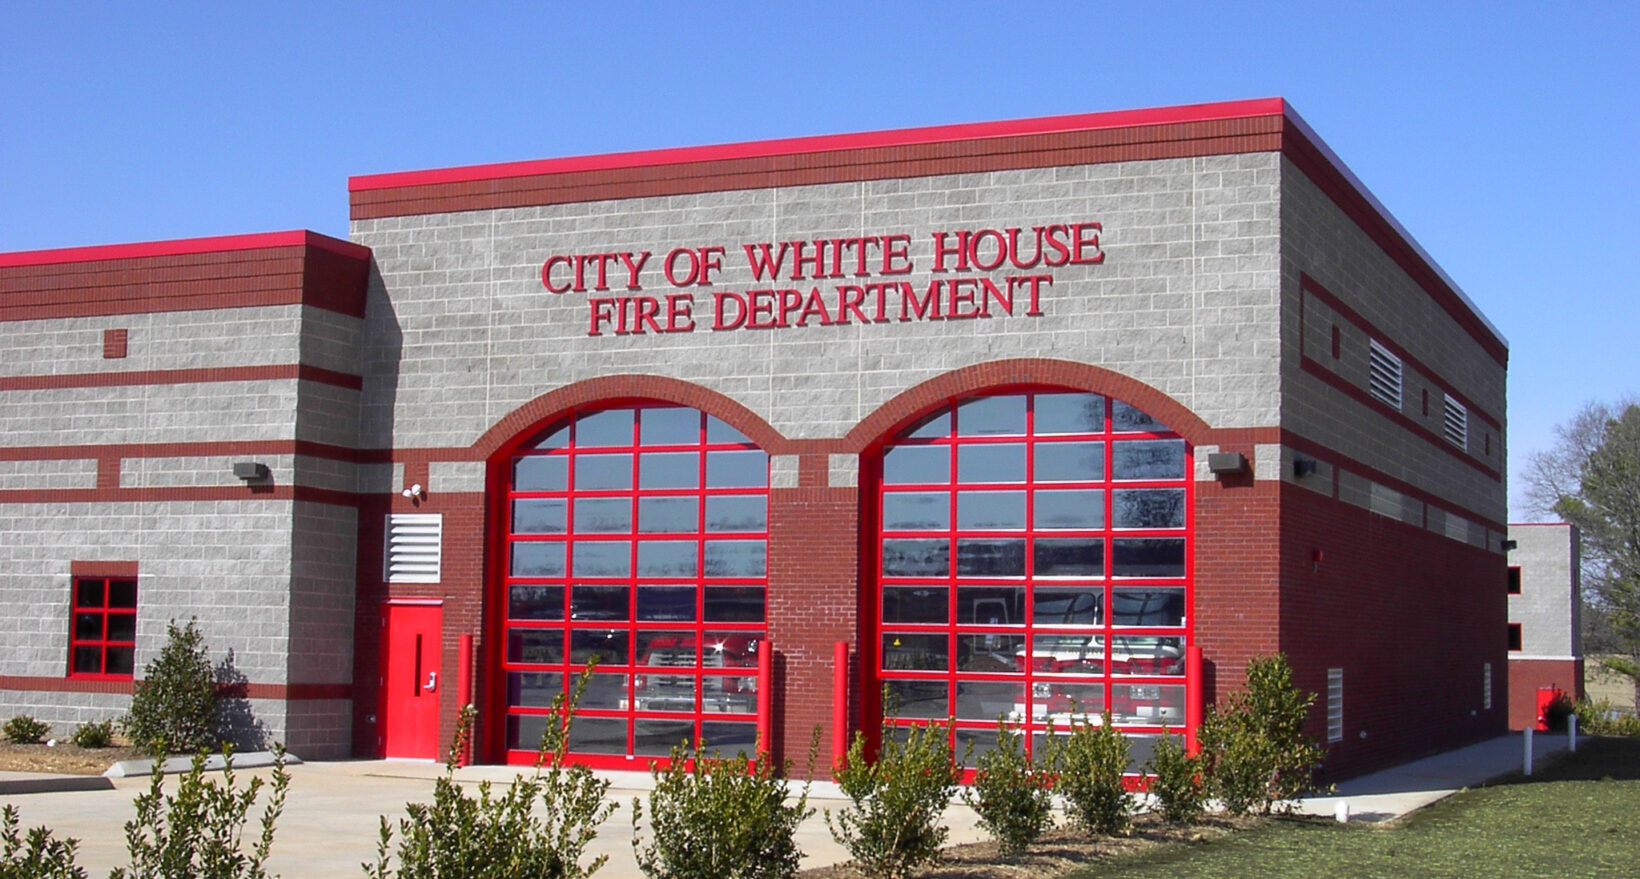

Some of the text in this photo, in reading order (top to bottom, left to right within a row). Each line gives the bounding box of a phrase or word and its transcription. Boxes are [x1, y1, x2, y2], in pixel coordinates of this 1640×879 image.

[541, 223, 1105, 294] CITY OF WHITE HOUSE
[589, 275, 1053, 337] FIRE DEPARTMENT
